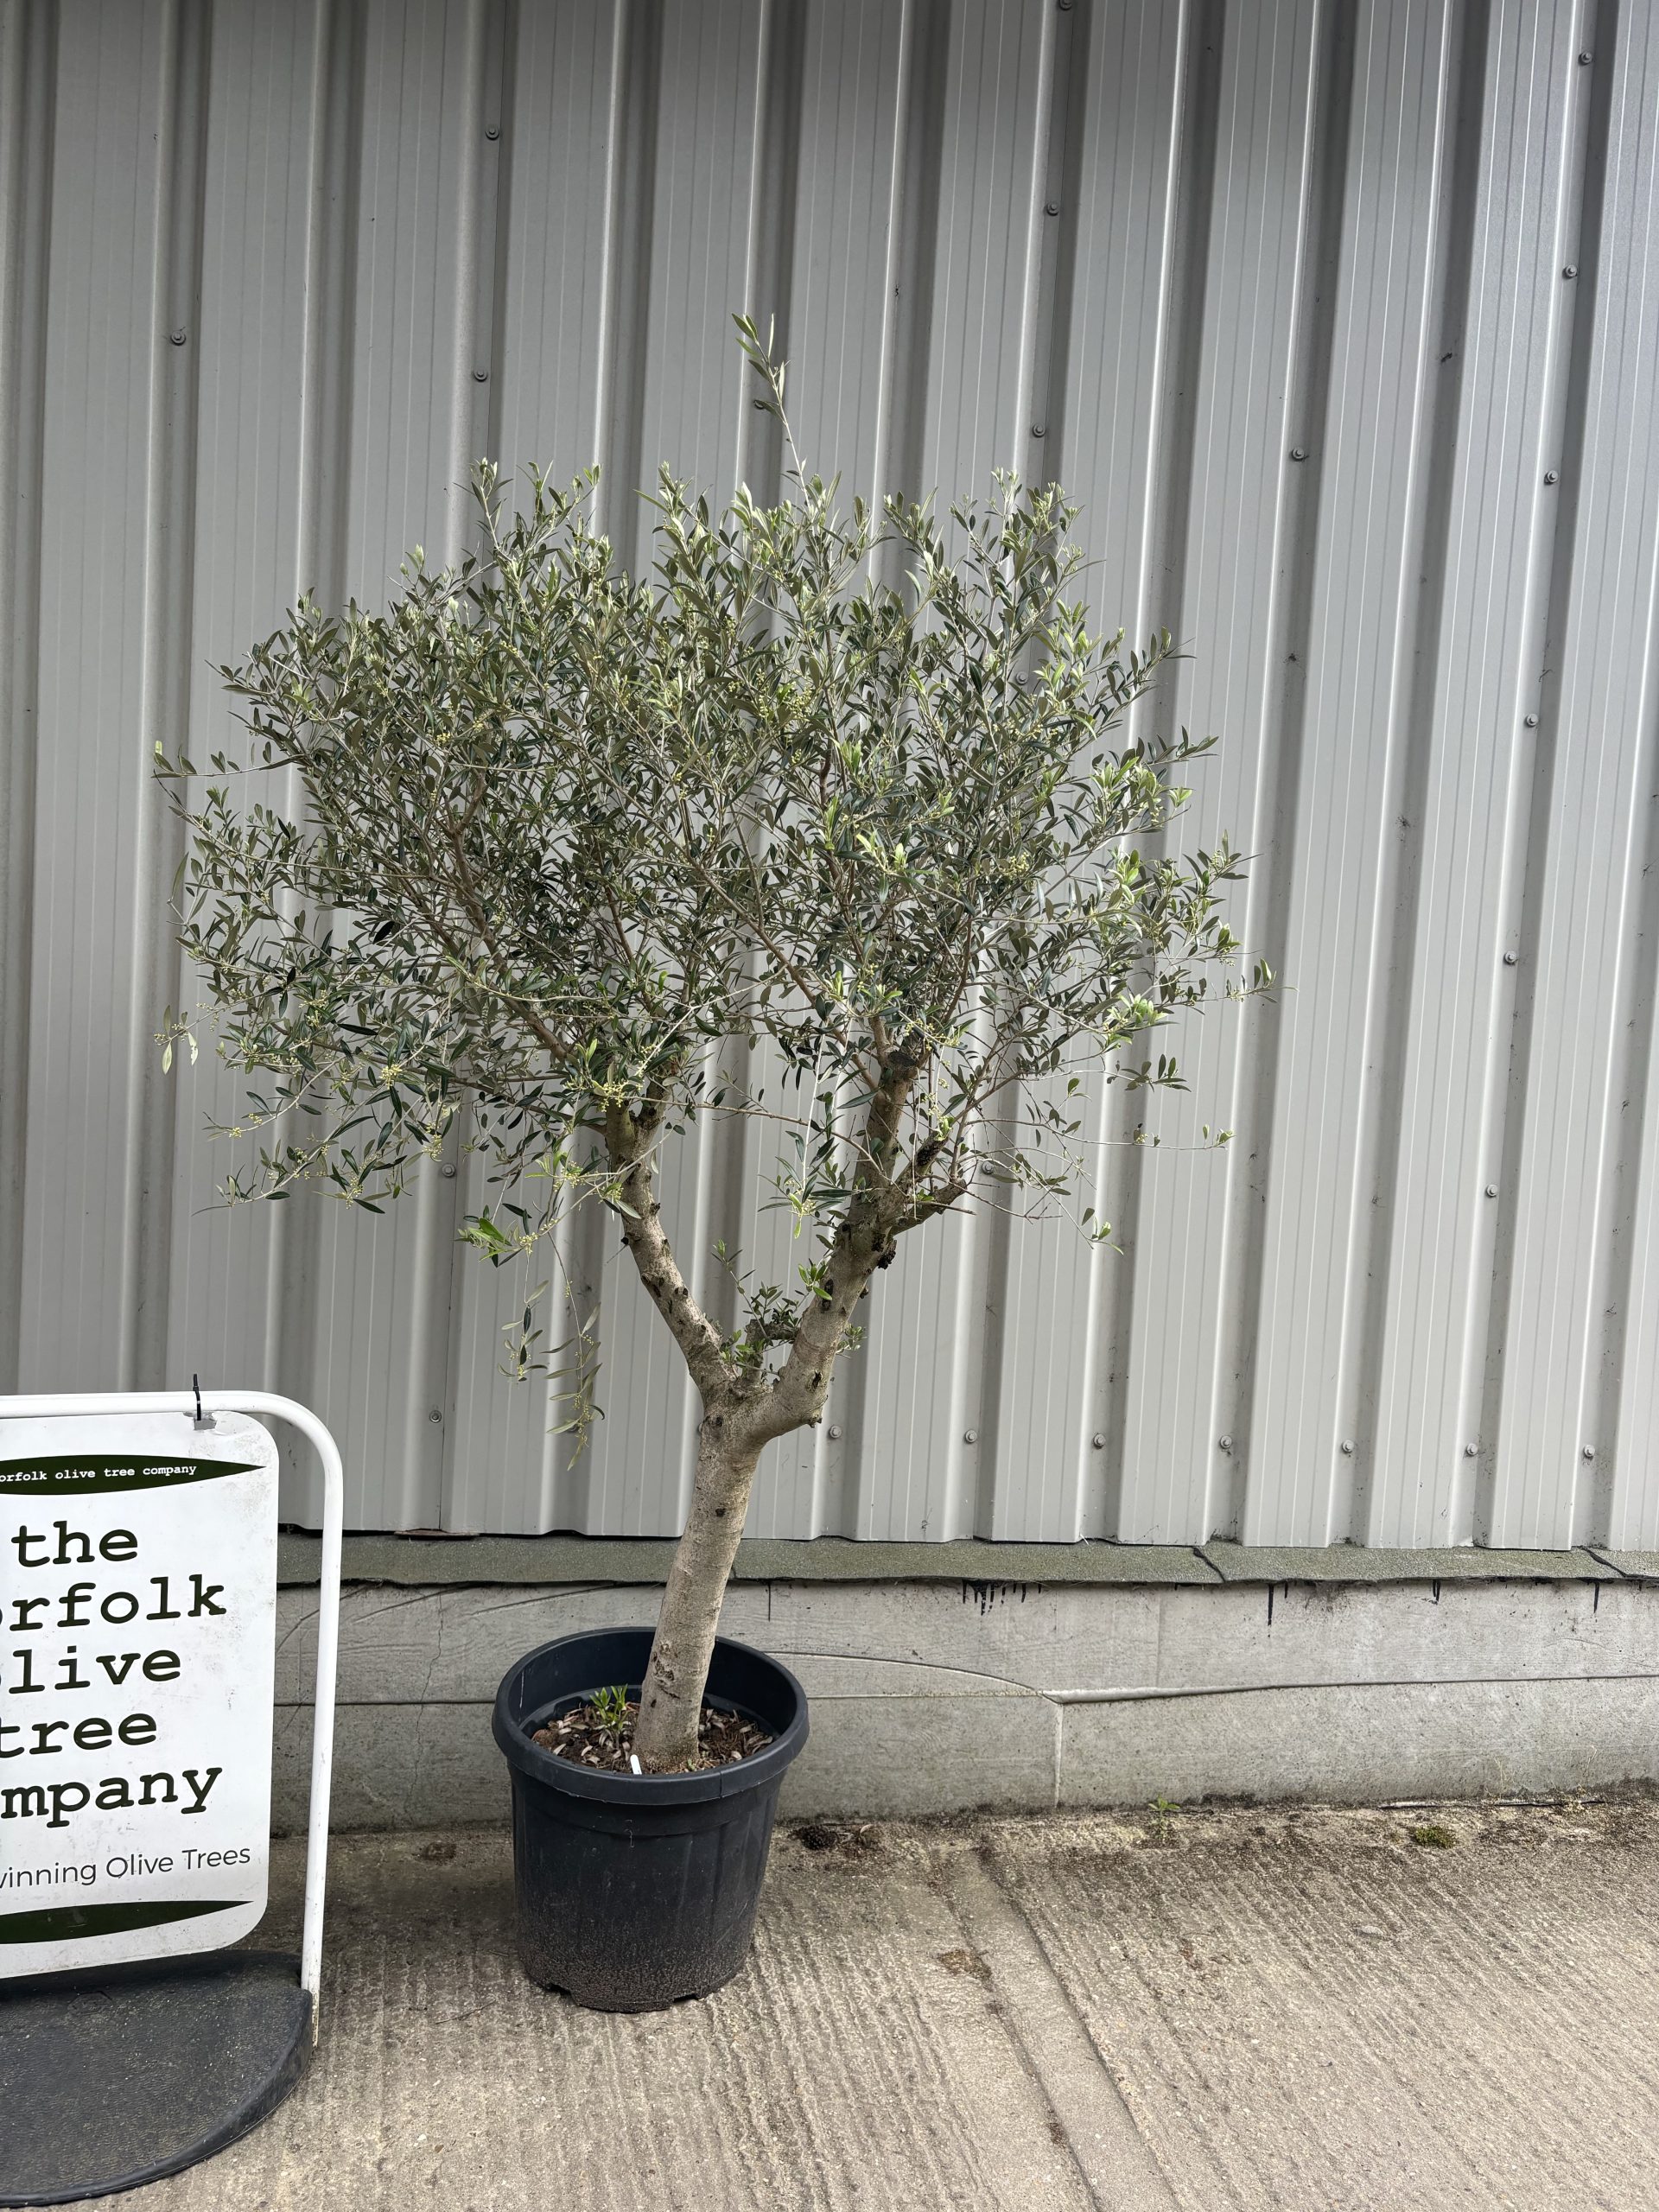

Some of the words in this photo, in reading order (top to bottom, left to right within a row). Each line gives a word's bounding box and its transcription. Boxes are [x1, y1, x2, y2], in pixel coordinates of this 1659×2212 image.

[54, 1469, 96, 1480] olive
[104, 1467, 136, 1478] tree
[143, 1465, 197, 1477] company
[10, 1520, 138, 1568] the
[0, 1573, 227, 1631] rfolk
[0, 1645, 181, 1694] live
[105, 1853, 174, 1878] Olive
[181, 1847, 251, 1870] Trees
